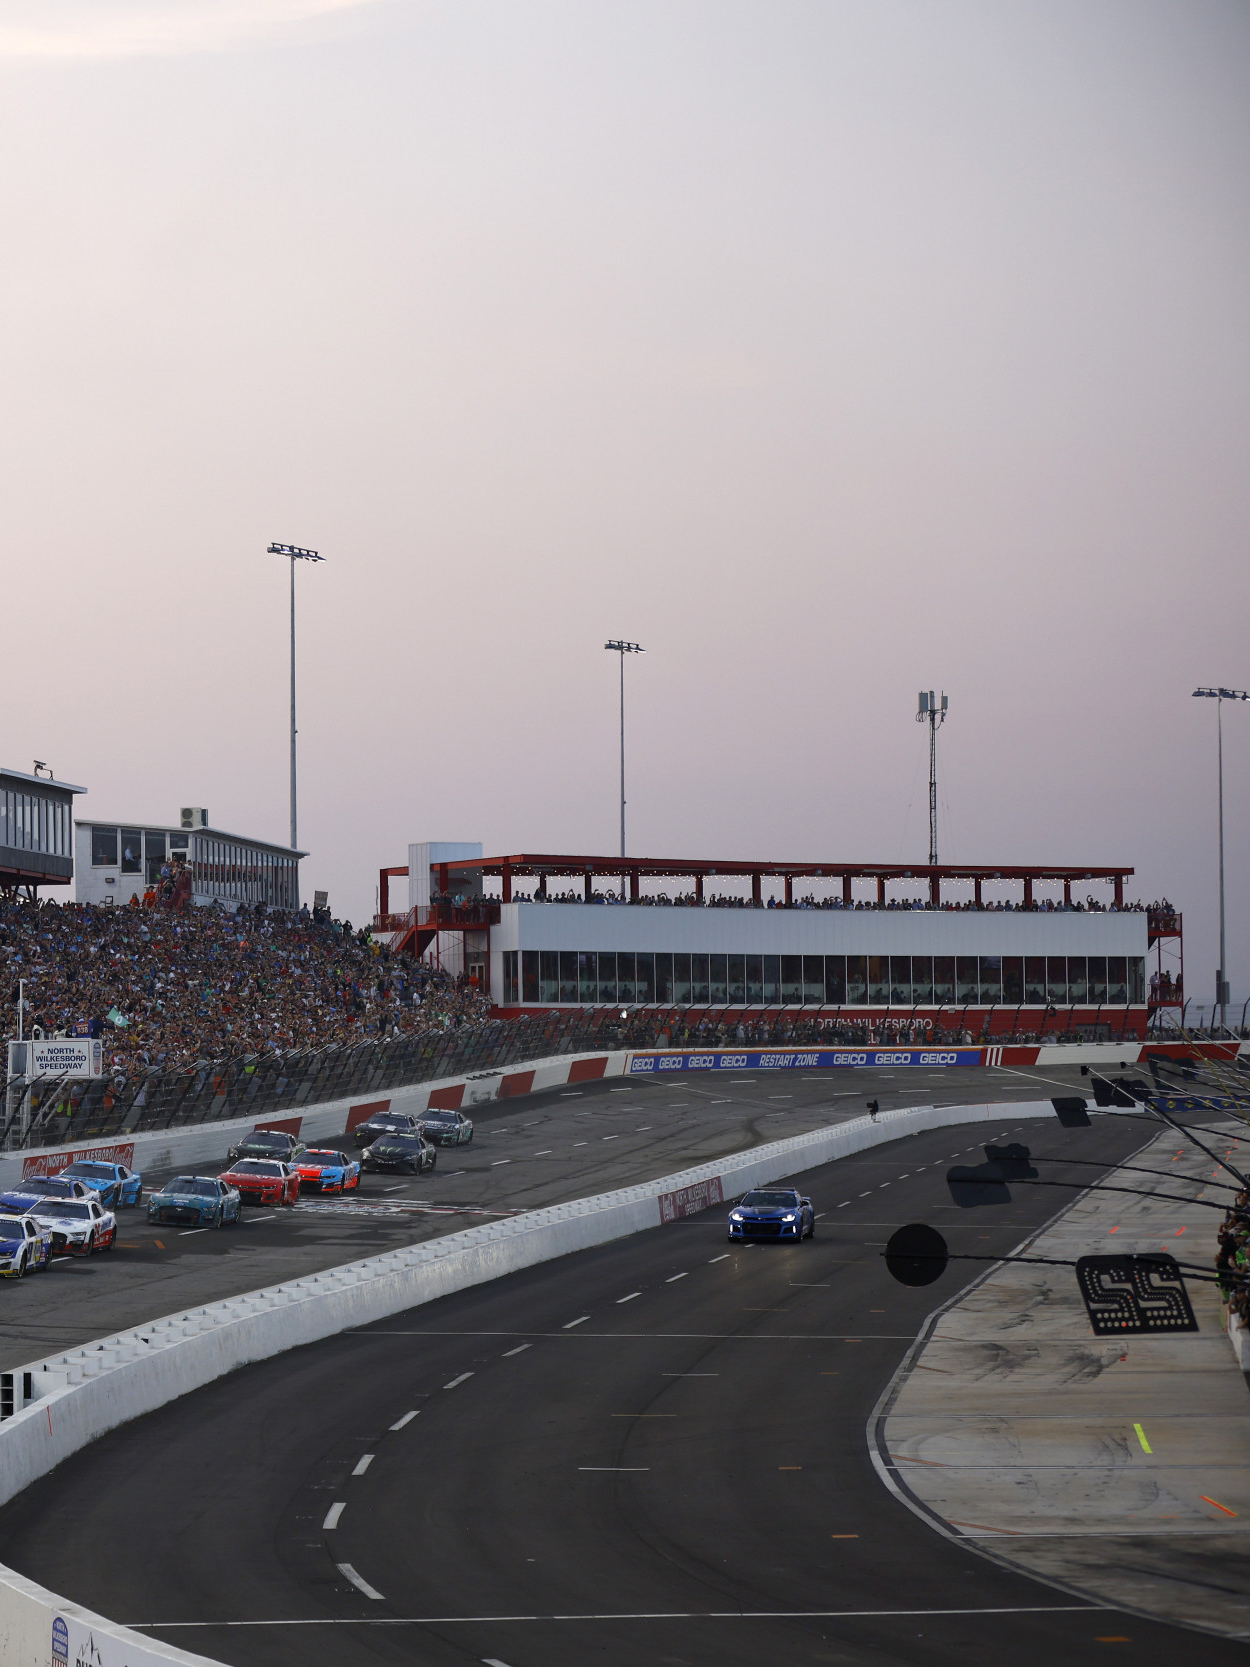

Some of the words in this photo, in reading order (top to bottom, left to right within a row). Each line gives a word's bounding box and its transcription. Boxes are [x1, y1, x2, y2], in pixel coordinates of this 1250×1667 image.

[631, 1058, 655, 1071] GEICO
[658, 1057, 683, 1069] GEICO
[688, 1055, 715, 1067] GEICO
[720, 1055, 747, 1067] GEICO
[759, 1054, 795, 1067] RESTART
[795, 1053, 820, 1066] ZONE
[833, 1053, 867, 1065] GEICO
[874, 1052, 912, 1064] GEICO
[919, 1052, 957, 1064] GEICO
[47, 1154, 69, 1168] NORTH
